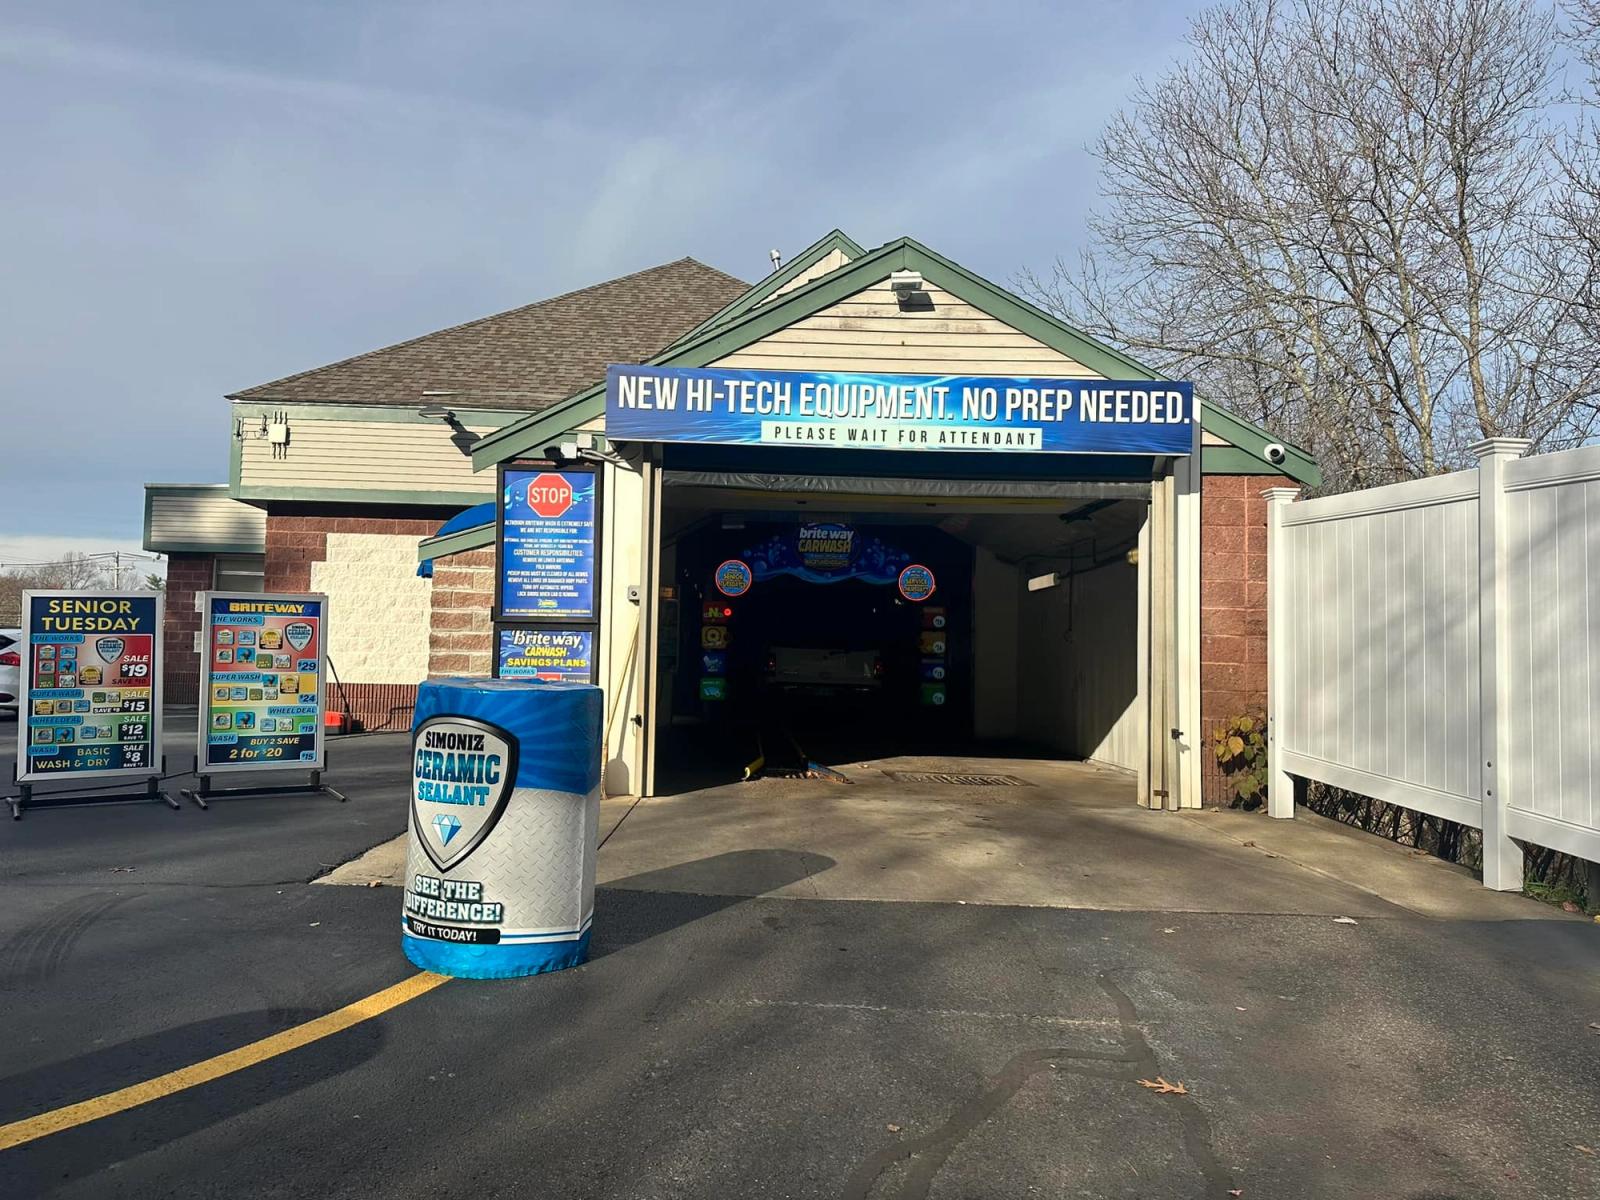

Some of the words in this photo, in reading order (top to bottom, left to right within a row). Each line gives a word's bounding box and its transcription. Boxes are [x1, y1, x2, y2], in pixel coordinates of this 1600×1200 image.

[618, 375, 679, 411] NEW
[686, 378, 792, 416] HI-TECH
[799, 383, 954, 420] EQUIPMENT.
[962, 387, 997, 421] NO
[1005, 388, 1073, 423] PREP
[1080, 390, 1190, 424] NEEDED.
[774, 426, 836, 441] PLEASE
[847, 428, 888, 442] WAIT
[897, 429, 927, 443] FOR
[939, 430, 1036, 445] ATTENDANT
[531, 487, 569, 504] STOP
[798, 539, 852, 553] CARWASH
[48, 599, 132, 614] SENIOR
[229, 602, 305, 613] BRITEWAY
[41, 617, 141, 631] TUESDAY
[552, 634, 582, 648] way
[525, 646, 567, 657] CARWASH
[123, 654, 150, 662] SALE
[507, 658, 552, 667] SAVINGS
[553, 658, 587, 668] PLANS
[121, 664, 148, 677] $19
[298, 662, 317, 671] $29
[210, 673, 239, 681] SUPER
[124, 690, 149, 698] SALE
[300, 694, 316, 703] $24
[123, 701, 146, 712] $15
[122, 724, 144, 734] $12
[301, 724, 314, 732] $19
[250, 738, 269, 746] BUY
[278, 737, 300, 745] SAVE
[425, 730, 485, 752] SIMONIZ
[77, 748, 111, 756] BASIC
[123, 744, 144, 752] SALE
[229, 748, 239, 759] 2
[240, 747, 260, 758] for
[262, 748, 283, 757] $20
[125, 752, 141, 762] $8
[302, 752, 314, 760] $15
[36, 760, 70, 769] WASH
[87, 758, 110, 767] DRY
[415, 748, 500, 786] CERAMIC
[418, 780, 490, 807] SEALANT
[415, 875, 441, 897] SEE
[442, 879, 482, 900] THE
[406, 891, 502, 922] DIFFERENCE!
[412, 920, 427, 934] TRY
[428, 926, 436, 936] IT
[436, 927, 478, 942] TODAY!
